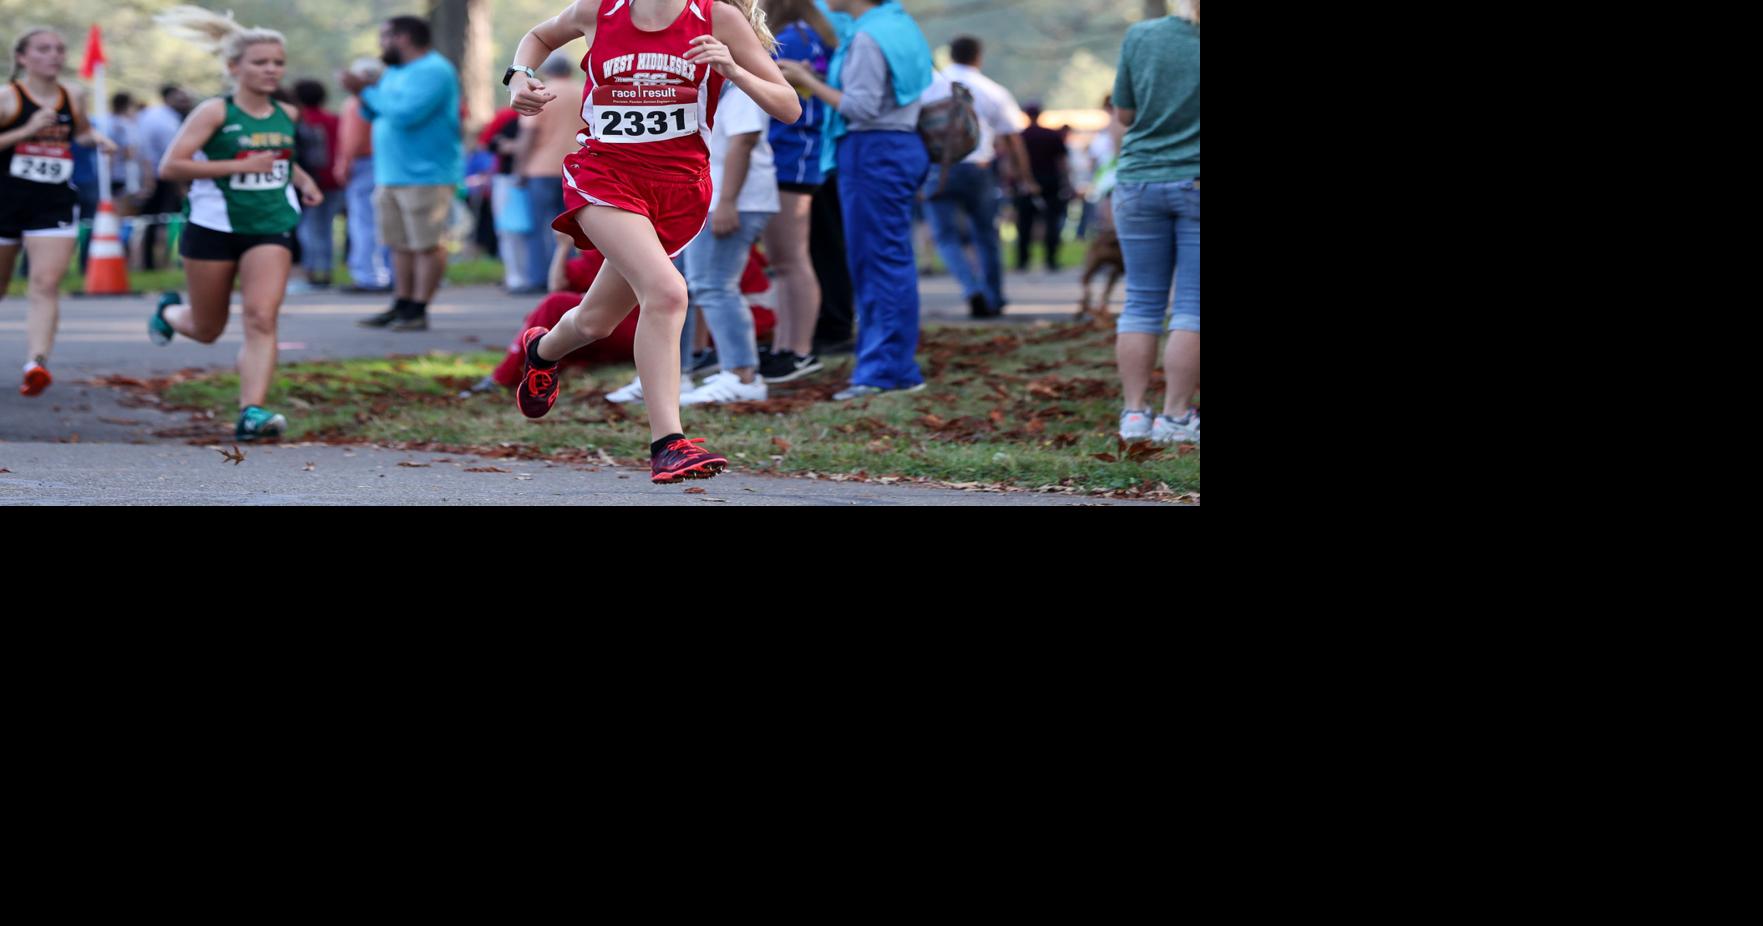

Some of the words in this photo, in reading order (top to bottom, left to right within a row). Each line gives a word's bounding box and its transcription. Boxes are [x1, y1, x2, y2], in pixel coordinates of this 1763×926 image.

[603, 53, 635, 79] WEST
[637, 52, 696, 81] MIDDLESEX
[611, 89, 636, 98] race
[643, 87, 677, 98] result
[601, 108, 686, 137] 2331
[21, 157, 63, 178] 249
